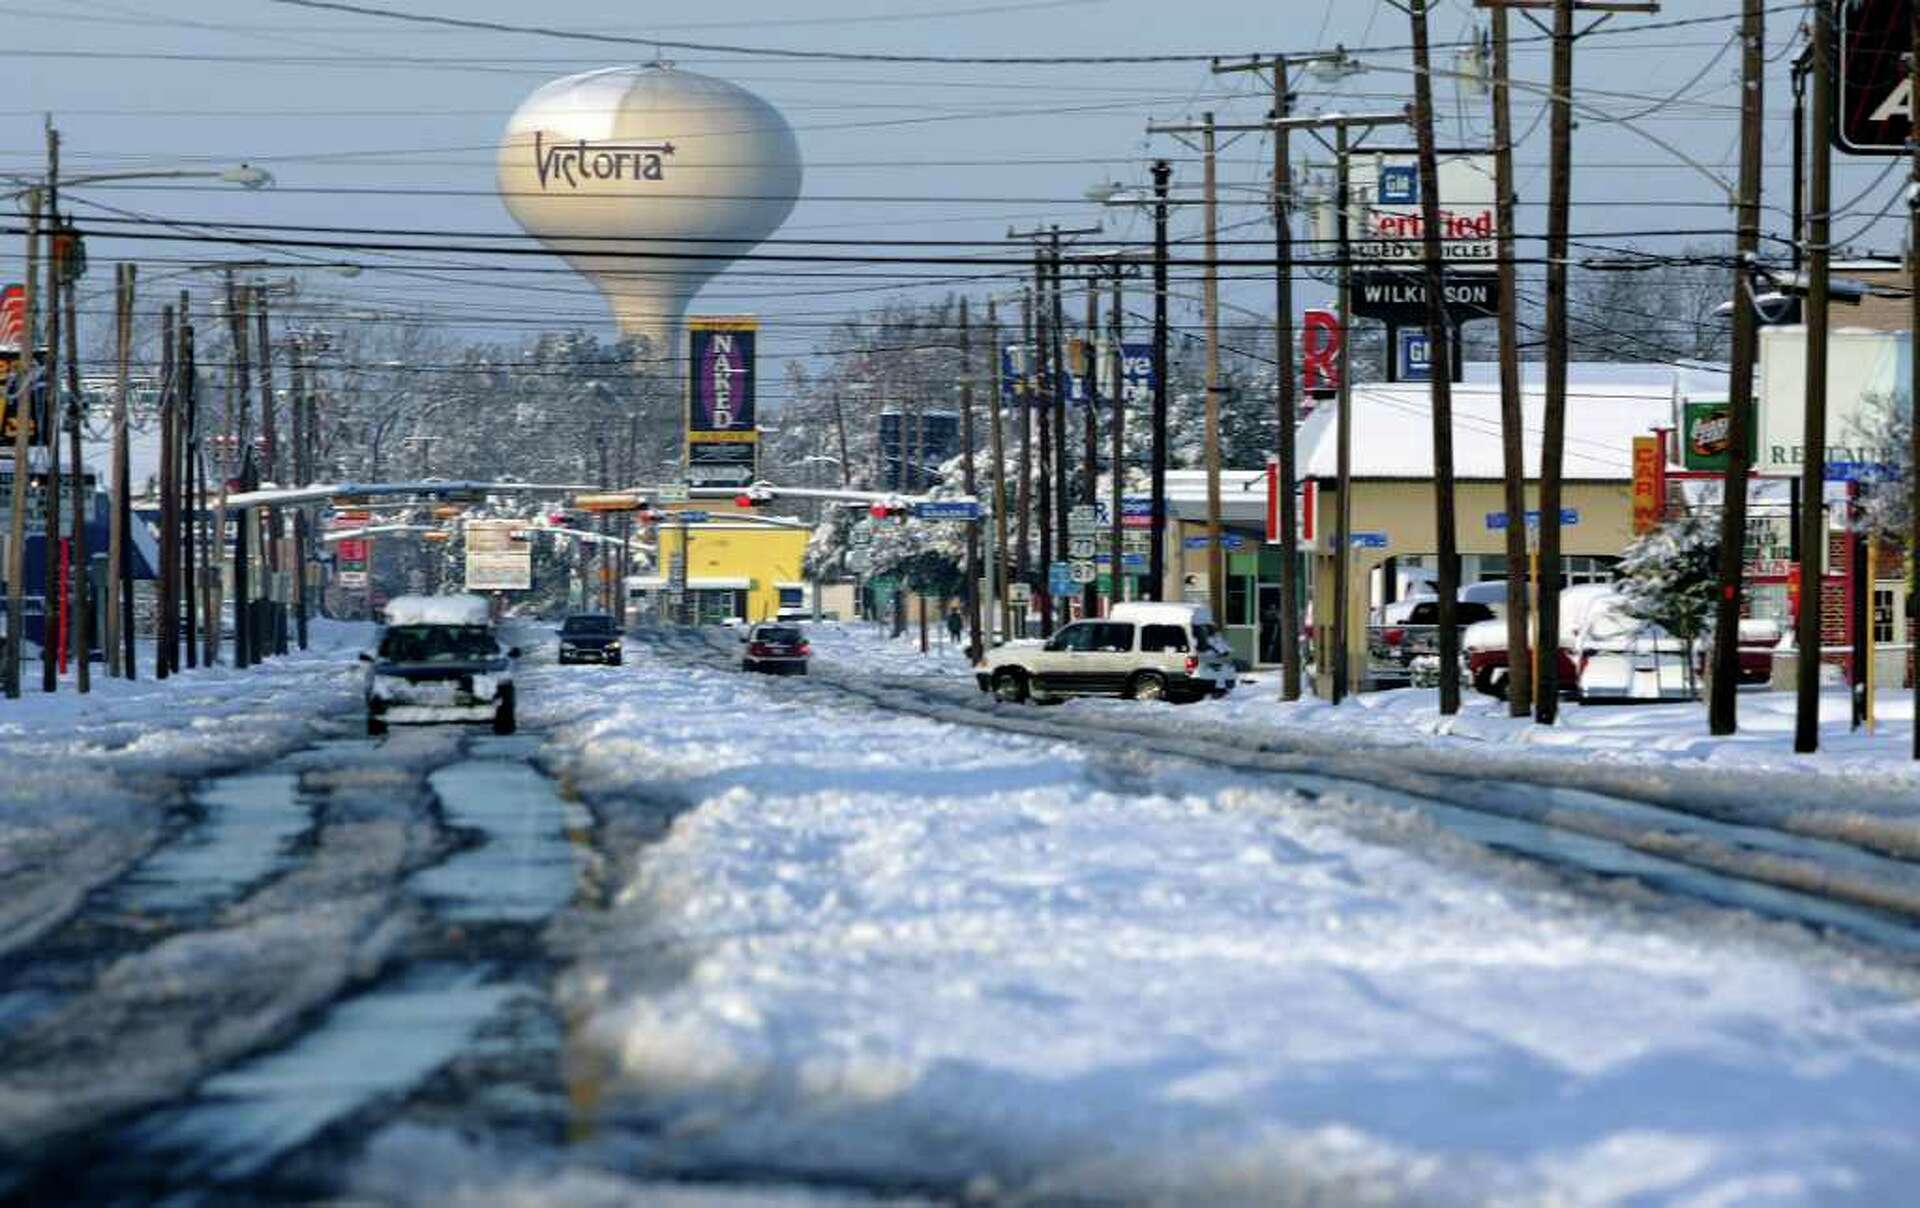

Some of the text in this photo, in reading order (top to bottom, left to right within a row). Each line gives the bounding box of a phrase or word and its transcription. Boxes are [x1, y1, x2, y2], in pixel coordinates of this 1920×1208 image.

[535, 130, 675, 190] Victoria
[1365, 209, 1491, 239] ertied
[1408, 244, 1493, 259] VICLES
[1364, 285, 1488, 304] WILKISON
